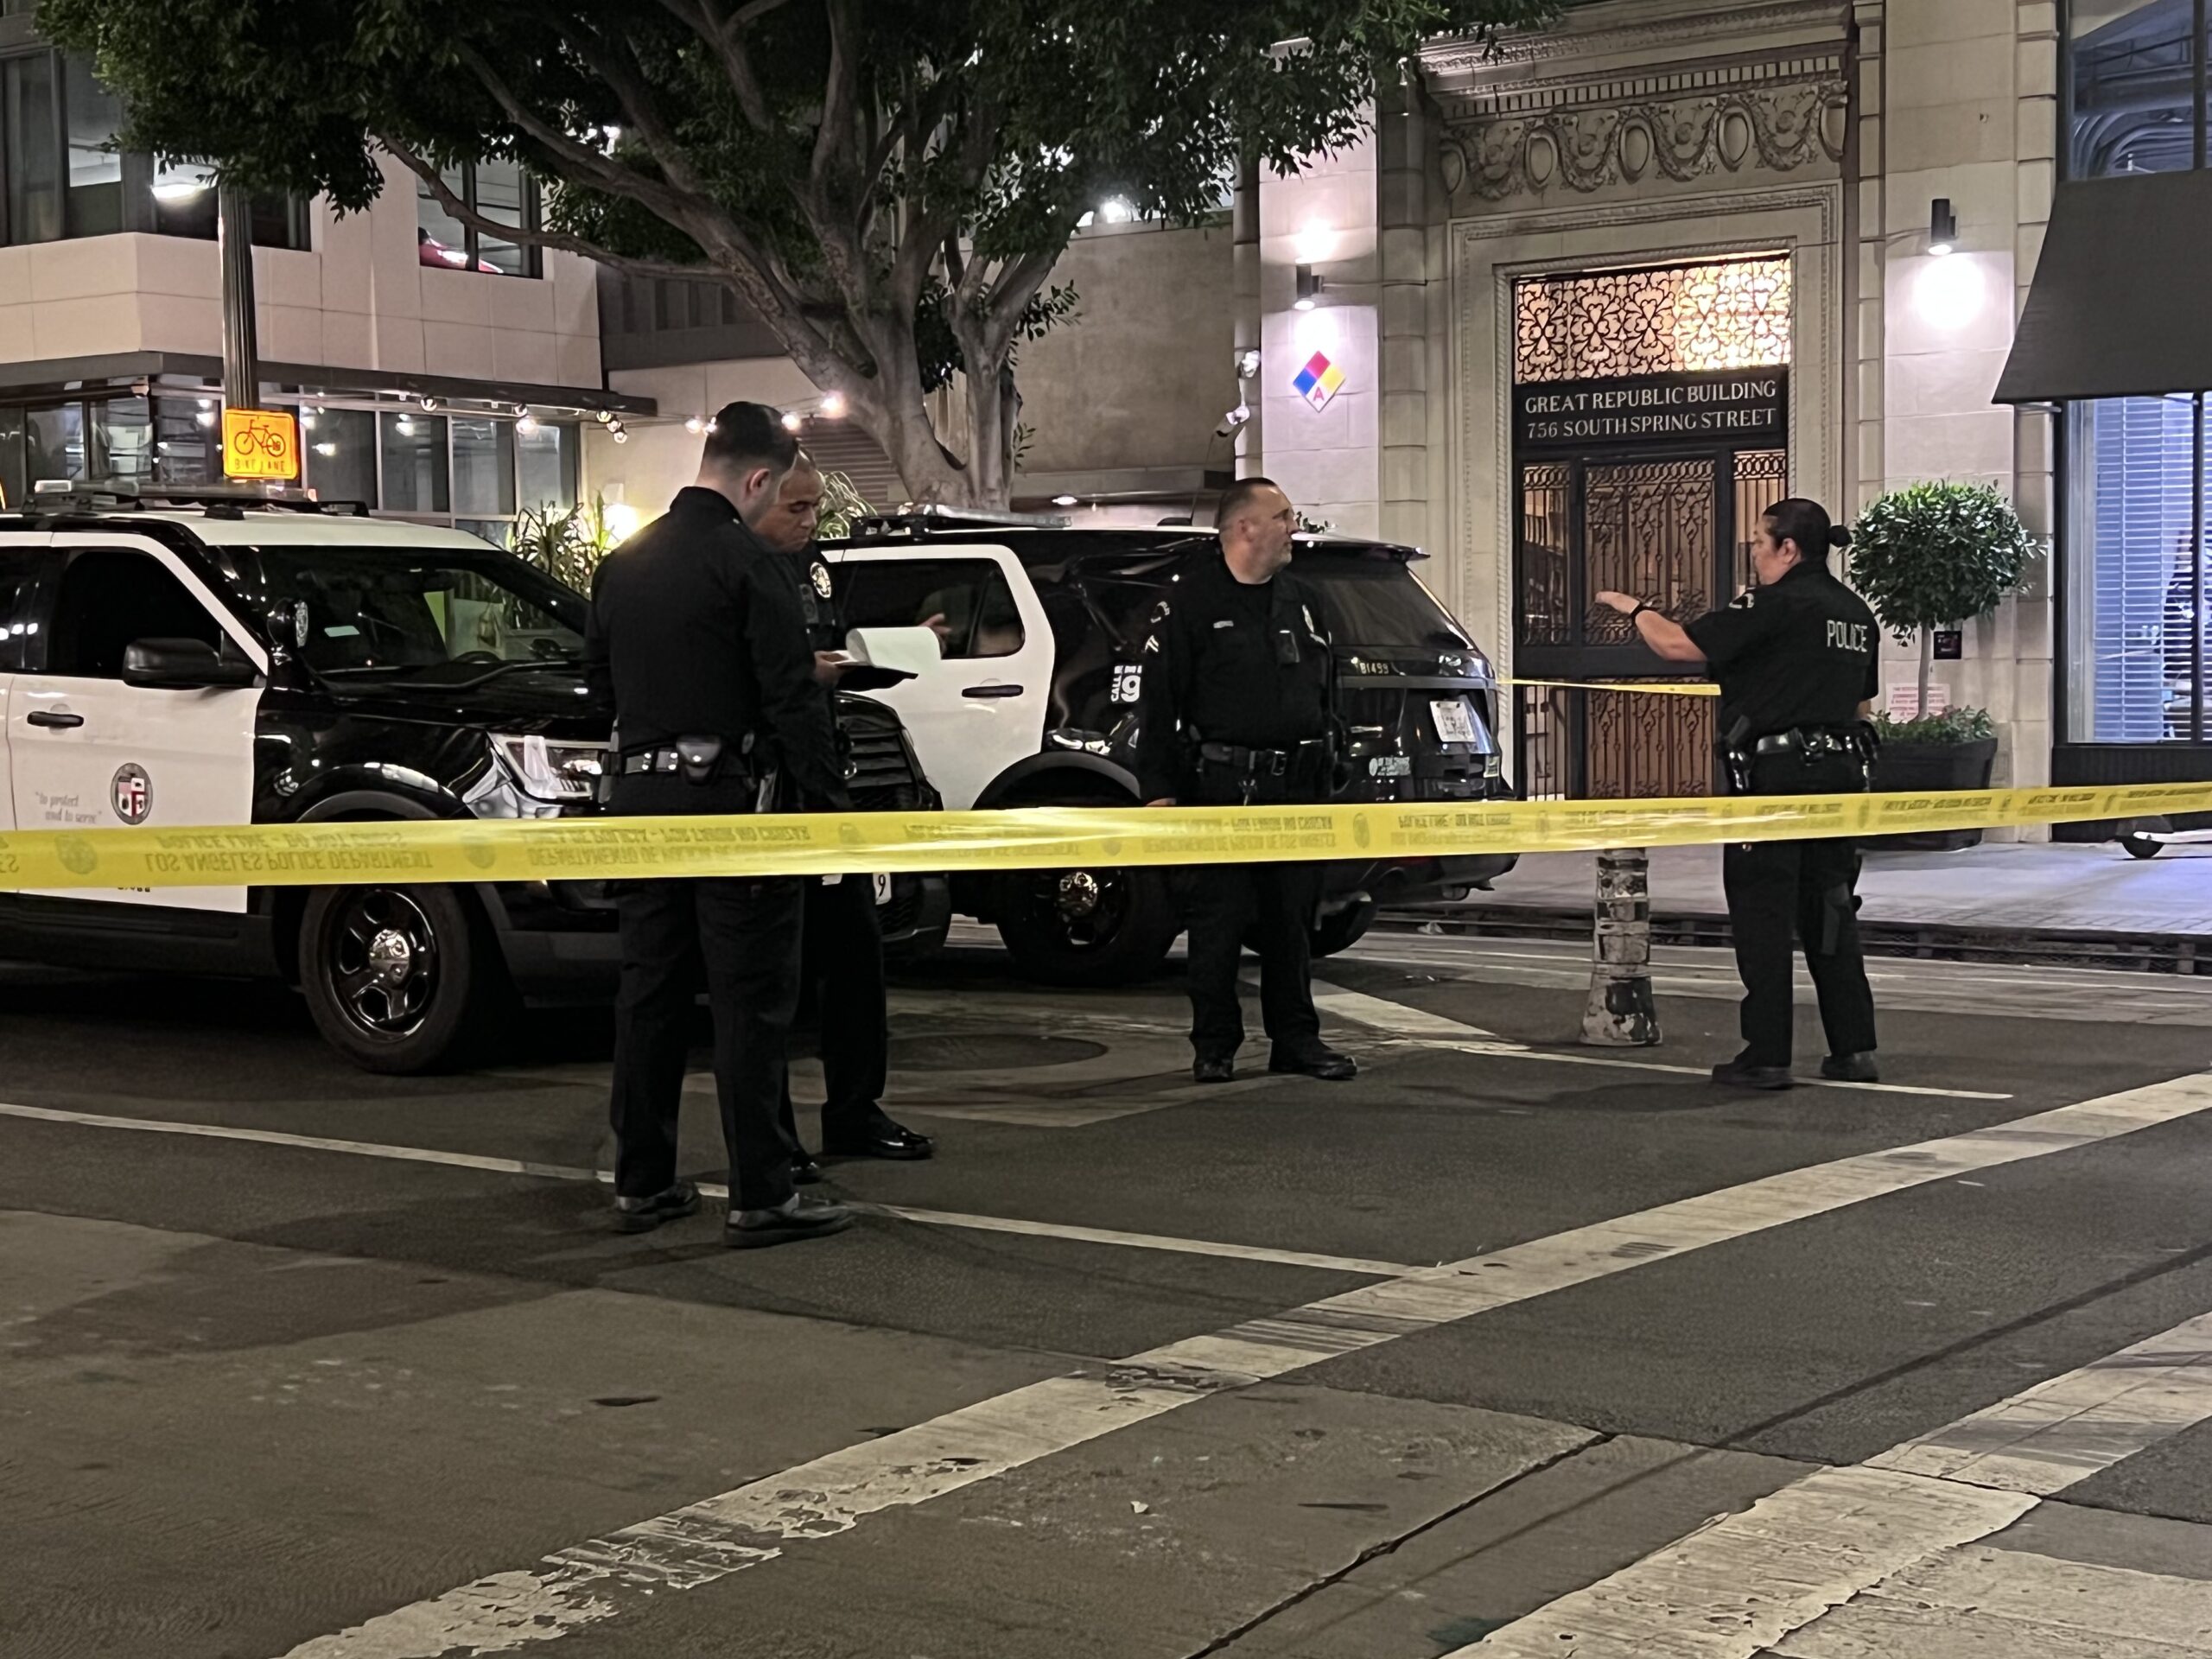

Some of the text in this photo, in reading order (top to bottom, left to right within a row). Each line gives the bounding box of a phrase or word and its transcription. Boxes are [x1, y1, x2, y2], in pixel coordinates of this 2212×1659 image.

[1525, 380, 1776, 414] GREAT REPUBLIC BUILDING
[1527, 408, 1777, 439] 756 SOUTH SPRING STREET
[234, 458, 285, 473] BIKE LANE
[1827, 620, 1868, 653] POLICE
[1110, 675, 1122, 702] CALL
